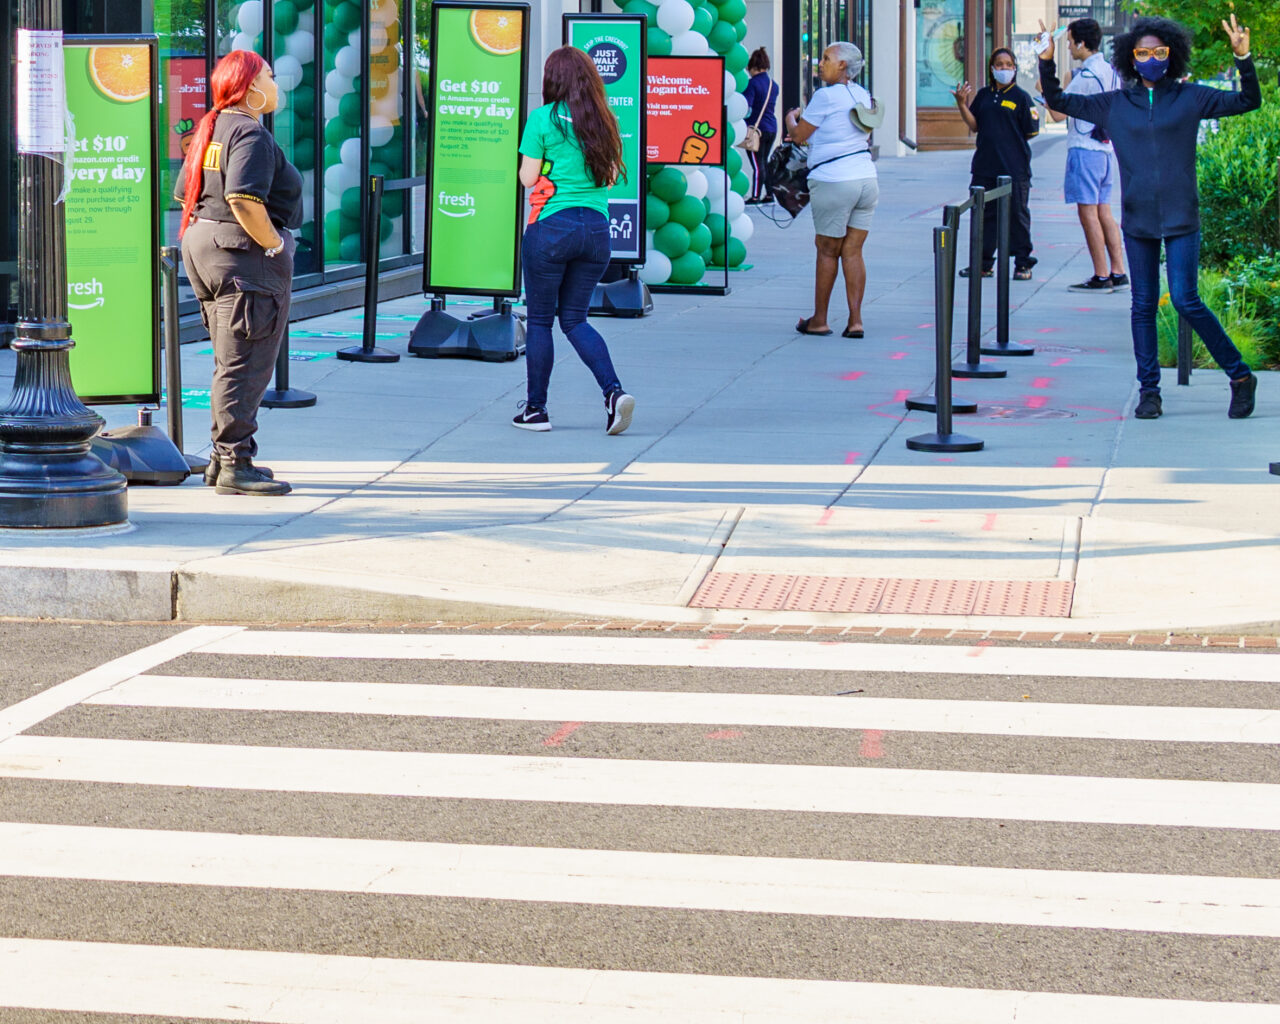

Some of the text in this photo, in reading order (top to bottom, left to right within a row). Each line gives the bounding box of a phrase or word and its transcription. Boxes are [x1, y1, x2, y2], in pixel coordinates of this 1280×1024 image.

[595, 49, 617, 57] JUST
[593, 57, 619, 65] WALK
[596, 64, 616, 72] OUT
[647, 75, 693, 85] Welcome
[439, 79, 468, 93] Get
[647, 85, 710, 96] Logan Circle.
[447, 95, 489, 103] Amazon.com
[490, 96, 510, 104] credit
[608, 96, 634, 106] ENTER
[439, 103, 516, 120] every day
[72, 154, 140, 164] mazon.com credit
[70, 163, 147, 184] very day
[72, 186, 91, 194] make
[98, 185, 133, 195] qualifying
[86, 195, 117, 206] purchase
[118, 195, 125, 203] of
[127, 194, 140, 204] $20
[438, 191, 475, 207] fresh
[67, 206, 88, 214] more,
[104, 204, 133, 214] through
[66, 217, 82, 225] gust
[67, 277, 103, 296] resh
